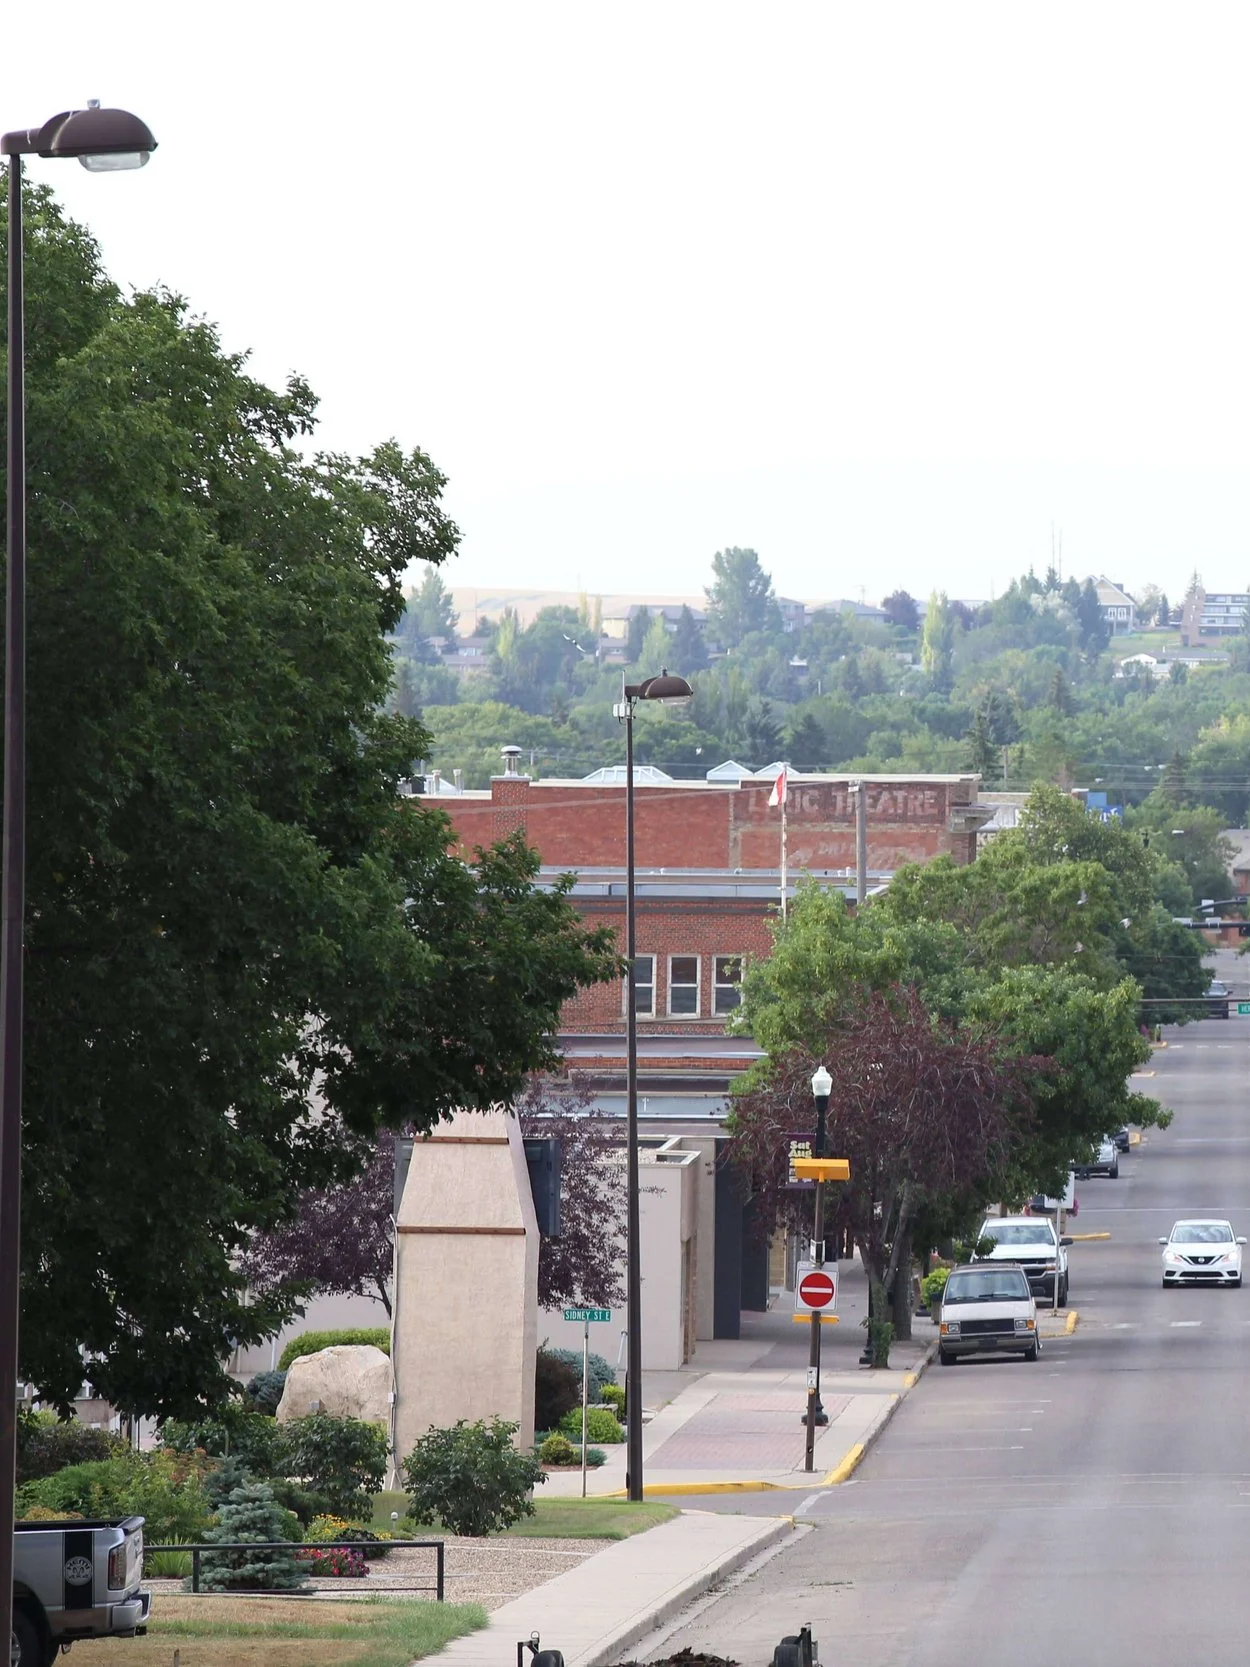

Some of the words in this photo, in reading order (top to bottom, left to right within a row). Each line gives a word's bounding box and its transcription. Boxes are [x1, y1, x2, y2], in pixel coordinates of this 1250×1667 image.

[832, 790, 938, 815] THEATRE
[790, 1141, 810, 1150] Sat
[788, 1150, 812, 1160] Aug
[565, 1311, 590, 1320] SIDNEY
[594, 1311, 602, 1320] ST
[605, 1311, 610, 1320] E
